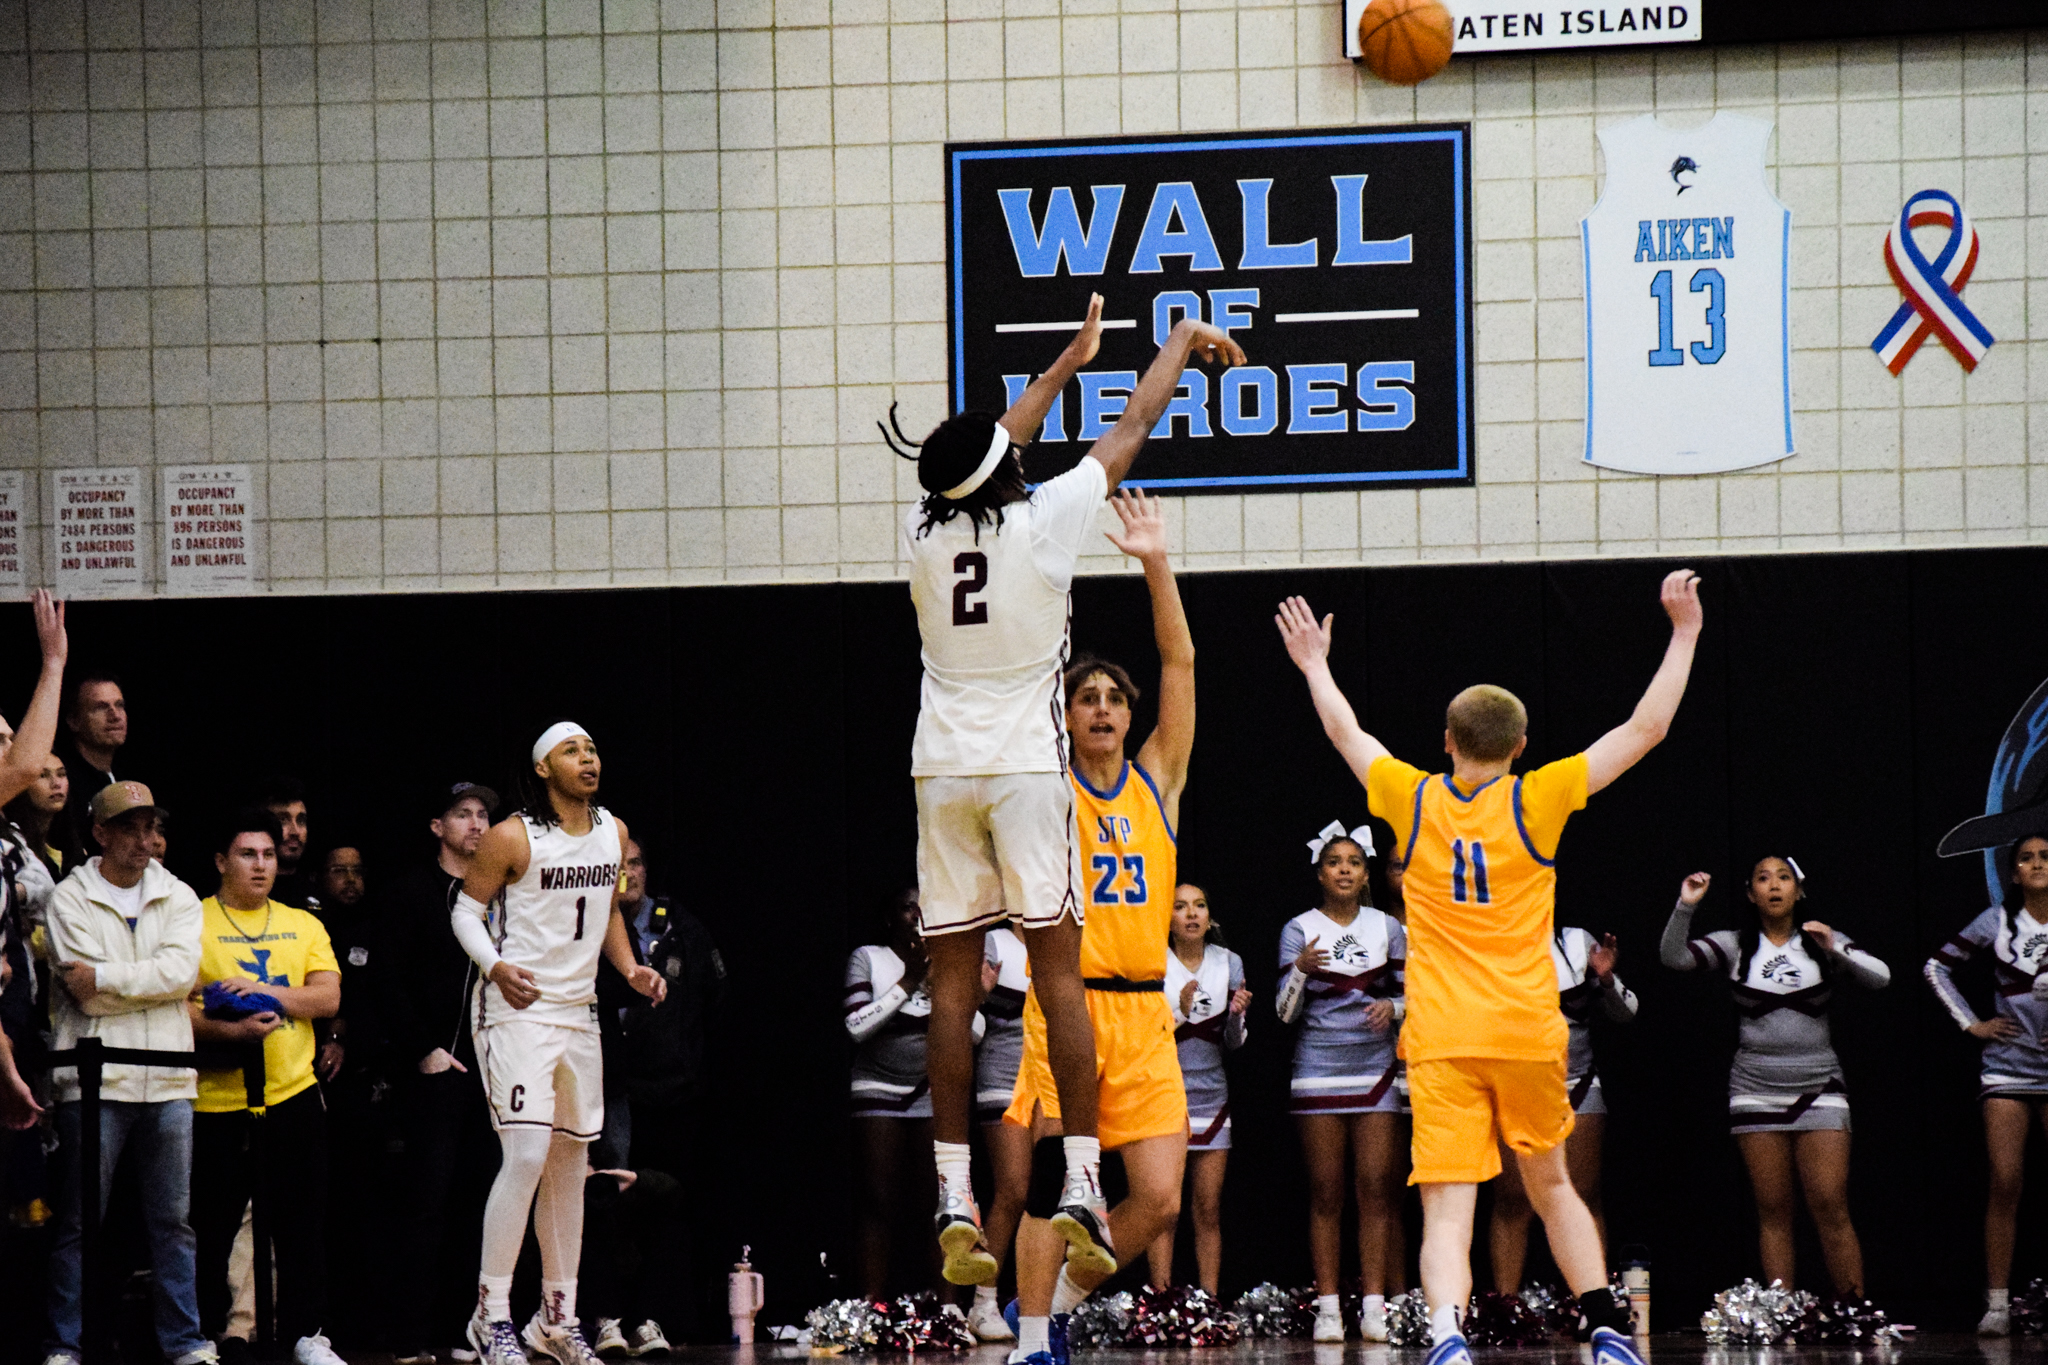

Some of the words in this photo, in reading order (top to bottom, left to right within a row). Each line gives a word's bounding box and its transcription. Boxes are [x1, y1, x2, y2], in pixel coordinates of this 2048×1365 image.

[1457, 12, 1544, 41] ATEN
[1560, 5, 1689, 35] ISLAND
[997, 174, 1413, 277] WALL
[1634, 216, 1735, 263] AIKEN
[1153, 287, 1260, 350] OF
[1649, 268, 1726, 367] 13
[1001, 360, 1415, 442] HEROES
[68, 490, 126, 503] OCCUPANCY
[178, 487, 235, 500] OCCUPANCY
[0, 510, 17, 521] HAN
[60, 508, 73, 520] BY
[77, 507, 104, 519] MORE
[109, 507, 135, 518] THAN
[170, 505, 182, 517] BY
[187, 504, 214, 516] MORE
[219, 503, 245, 515] THAN
[90, 523, 135, 536] PERSONS
[174, 521, 192, 533] 896
[197, 519, 242, 532] PERSONS
[61, 541, 72, 553] IS
[76, 539, 135, 552] DANGEROUS
[171, 537, 182, 550] IS
[186, 536, 245, 550] DANGEROUS
[61, 558, 81, 570] AND
[85, 556, 137, 569] UNLAWFUL
[171, 555, 190, 567] AND
[195, 553, 247, 566] UNLAWFUL
[953, 551, 988, 626] 2
[1097, 815, 1131, 843] STP
[540, 863, 617, 890] WARRIORS
[1090, 853, 1148, 905] 23
[1450, 836, 1491, 905] 11
[573, 895, 586, 941] 1
[510, 1084, 525, 1113] C
